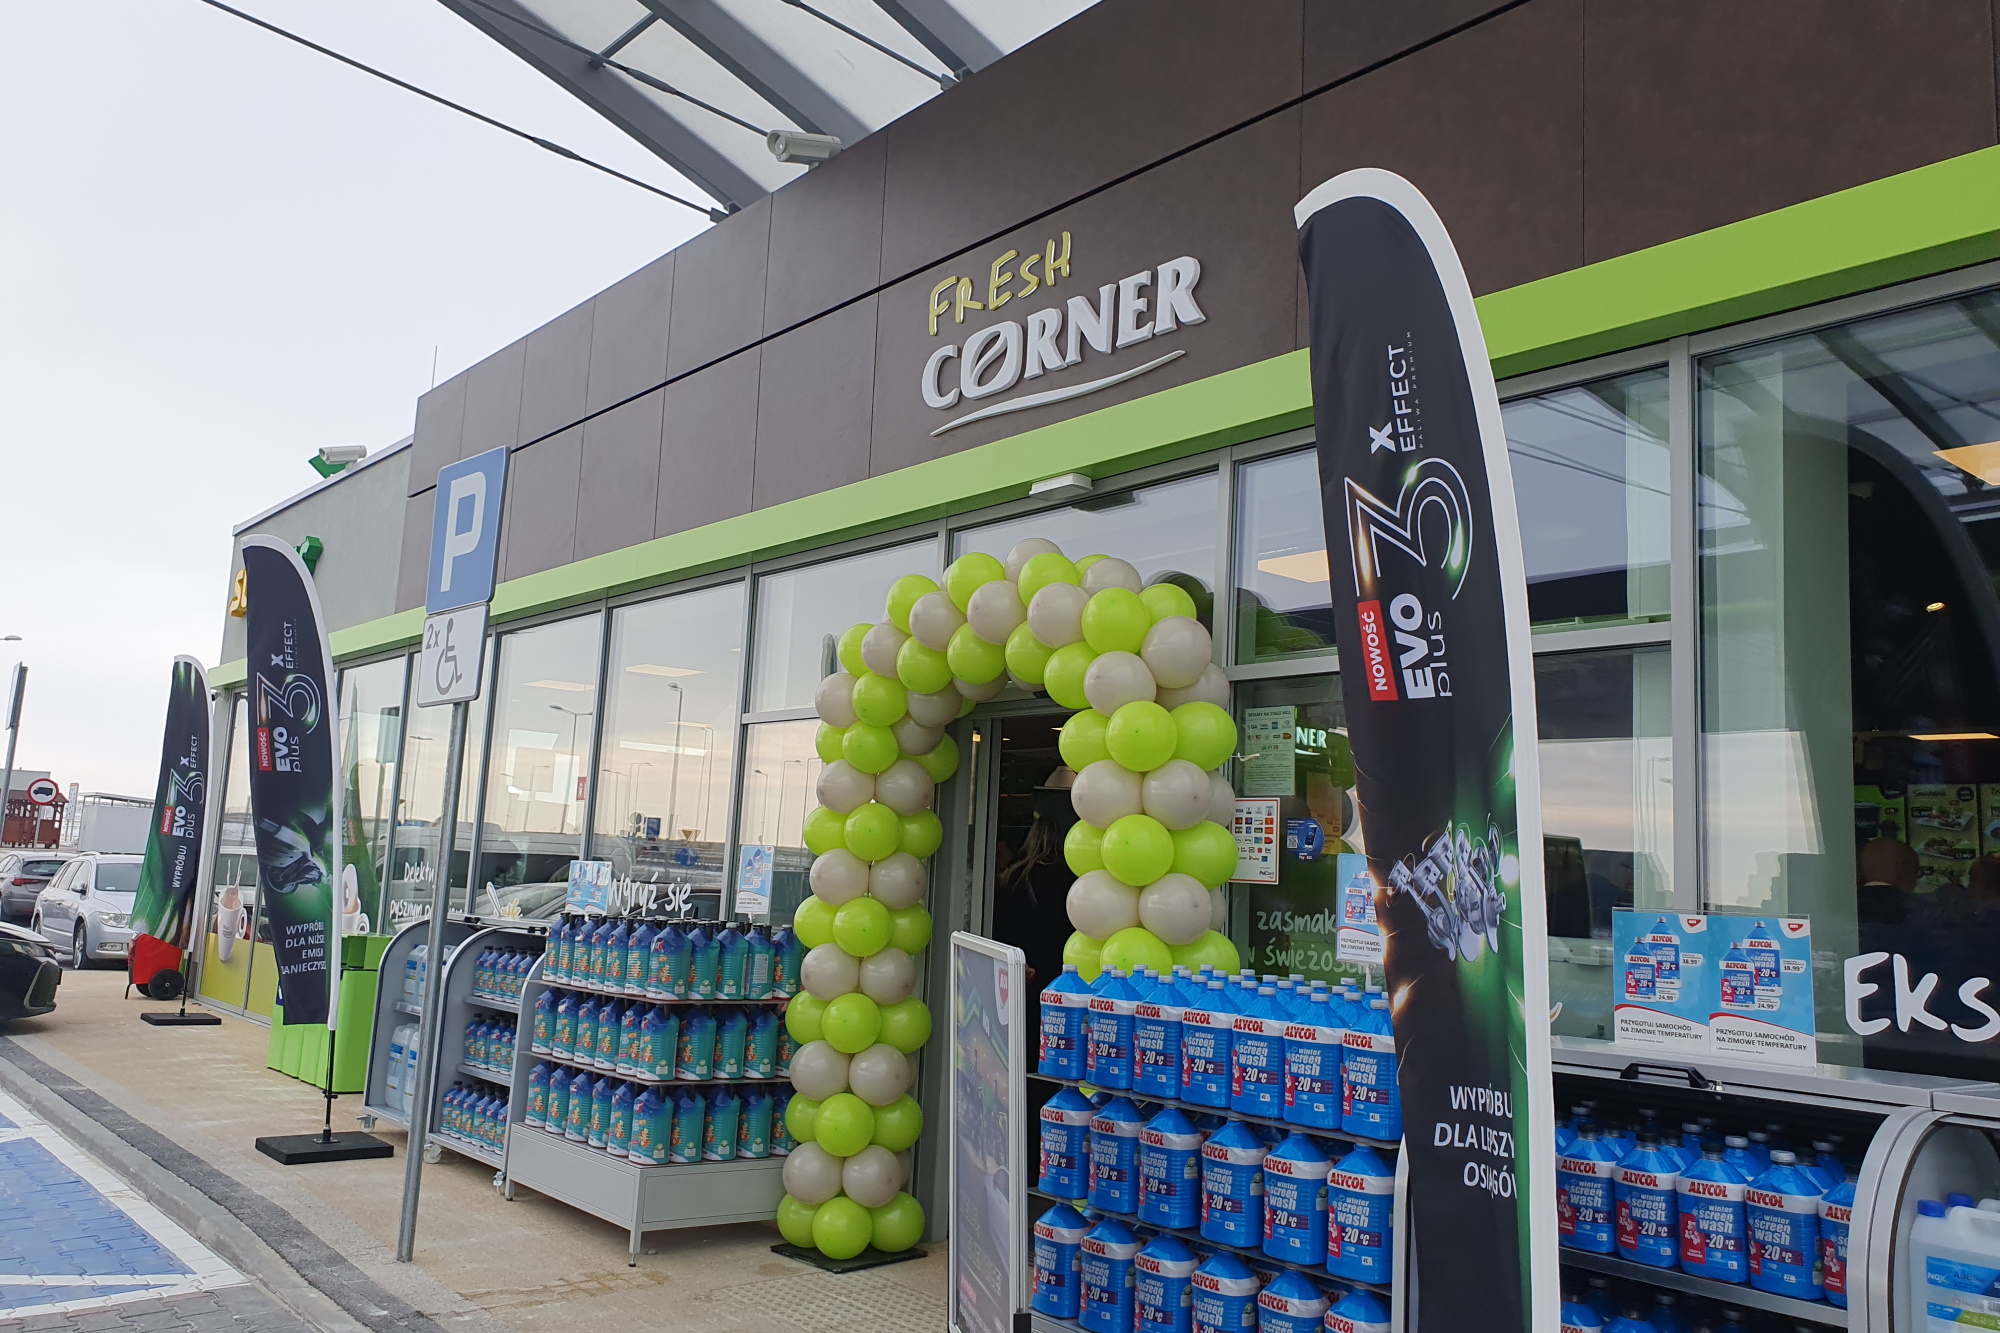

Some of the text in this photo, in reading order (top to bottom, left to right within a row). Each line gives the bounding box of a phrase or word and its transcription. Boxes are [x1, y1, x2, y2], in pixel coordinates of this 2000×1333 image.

[929, 230, 1071, 336] FRESH
[1406, 332, 1424, 449] PALIWA PREMIUM
[1388, 345, 1416, 452] EFFECT
[1369, 421, 1397, 454] X
[441, 472, 486, 592] P
[426, 624, 441, 649] 2x
[284, 621, 294, 669] EFFECT
[1363, 610, 1388, 690] NOWOŚĆ
[1390, 593, 1436, 699] EVO
[271, 653, 285, 667] X
[1428, 611, 1453, 697] plus
[189, 735, 198, 768] EFFECT
[261, 731, 269, 767] NOWOŚĆ
[273, 726, 292, 772] EVO
[292, 736, 302, 773] plus
[172, 805, 187, 837] EVO
[185, 813, 196, 838] plus
[172, 845, 187, 888] WYPRÓBUJ
[608, 871, 693, 919] Wgryź się
[286, 937, 306, 949] DLA
[1041, 992, 1062, 1004] ALYCOL
[1089, 999, 1114, 1011] ALYCOL
[1135, 1005, 1161, 1018] ALYCOL
[1183, 1011, 1210, 1025] ALYCOL
[1044, 1016, 1066, 1024] screen
[1234, 1018, 1264, 1032] ALYCOL
[1620, 1019, 1692, 1031] PRZYGOTUJ SAMOCHÓD
[1044, 1024, 1065, 1034] wash
[1094, 1023, 1117, 1033] screen
[1140, 1030, 1164, 1039] screen
[1285, 1026, 1317, 1040] ALYCOL
[1630, 1027, 1656, 1036] ZIMOWE
[1658, 1030, 1702, 1040] TEMPERATURY
[1716, 1028, 1795, 1042] PRZYGOTUJ SAMOCHÓD
[1093, 1031, 1116, 1042] wash
[1140, 1038, 1163, 1050] wash
[1188, 1037, 1214, 1047] screen
[1343, 1033, 1373, 1048] ALYCOL
[1727, 1036, 1756, 1046] ZIMOWE
[1757, 1040, 1807, 1051] TEMPERATURY
[1188, 1046, 1213, 1058] wash
[1239, 1045, 1268, 1056] screen
[1239, 1054, 1266, 1067] wash
[1291, 1053, 1321, 1064] screen
[1290, 1062, 1320, 1076] wash
[1349, 1062, 1377, 1073] screen
[1349, 1070, 1376, 1085] wash
[1434, 1122, 1478, 1150] DLA
[1264, 1158, 1293, 1175] ALYCOL
[1561, 1159, 1597, 1174] ALYCOL
[1330, 1172, 1365, 1190] ALYCOL
[1464, 1161, 1518, 1199] OSIĄGÓ
[1622, 1171, 1658, 1187] ALYCOL
[1570, 1186, 1602, 1196] screen
[1688, 1182, 1727, 1198] ALYCOL
[1570, 1194, 1601, 1207] wash
[1632, 1198, 1666, 1210] screen
[1746, 1190, 1784, 1208] ALYCOL
[1337, 1203, 1370, 1216] screen
[1632, 1208, 1665, 1221] wash
[1699, 1210, 1733, 1222] screen
[1337, 1212, 1368, 1227] wash
[1699, 1220, 1733, 1234] wash
[1755, 1219, 1791, 1234] screen
[1755, 1229, 1790, 1246] wash
[1192, 1273, 1220, 1291] ALYCOL
[1258, 1293, 1289, 1312] ALYCOL
